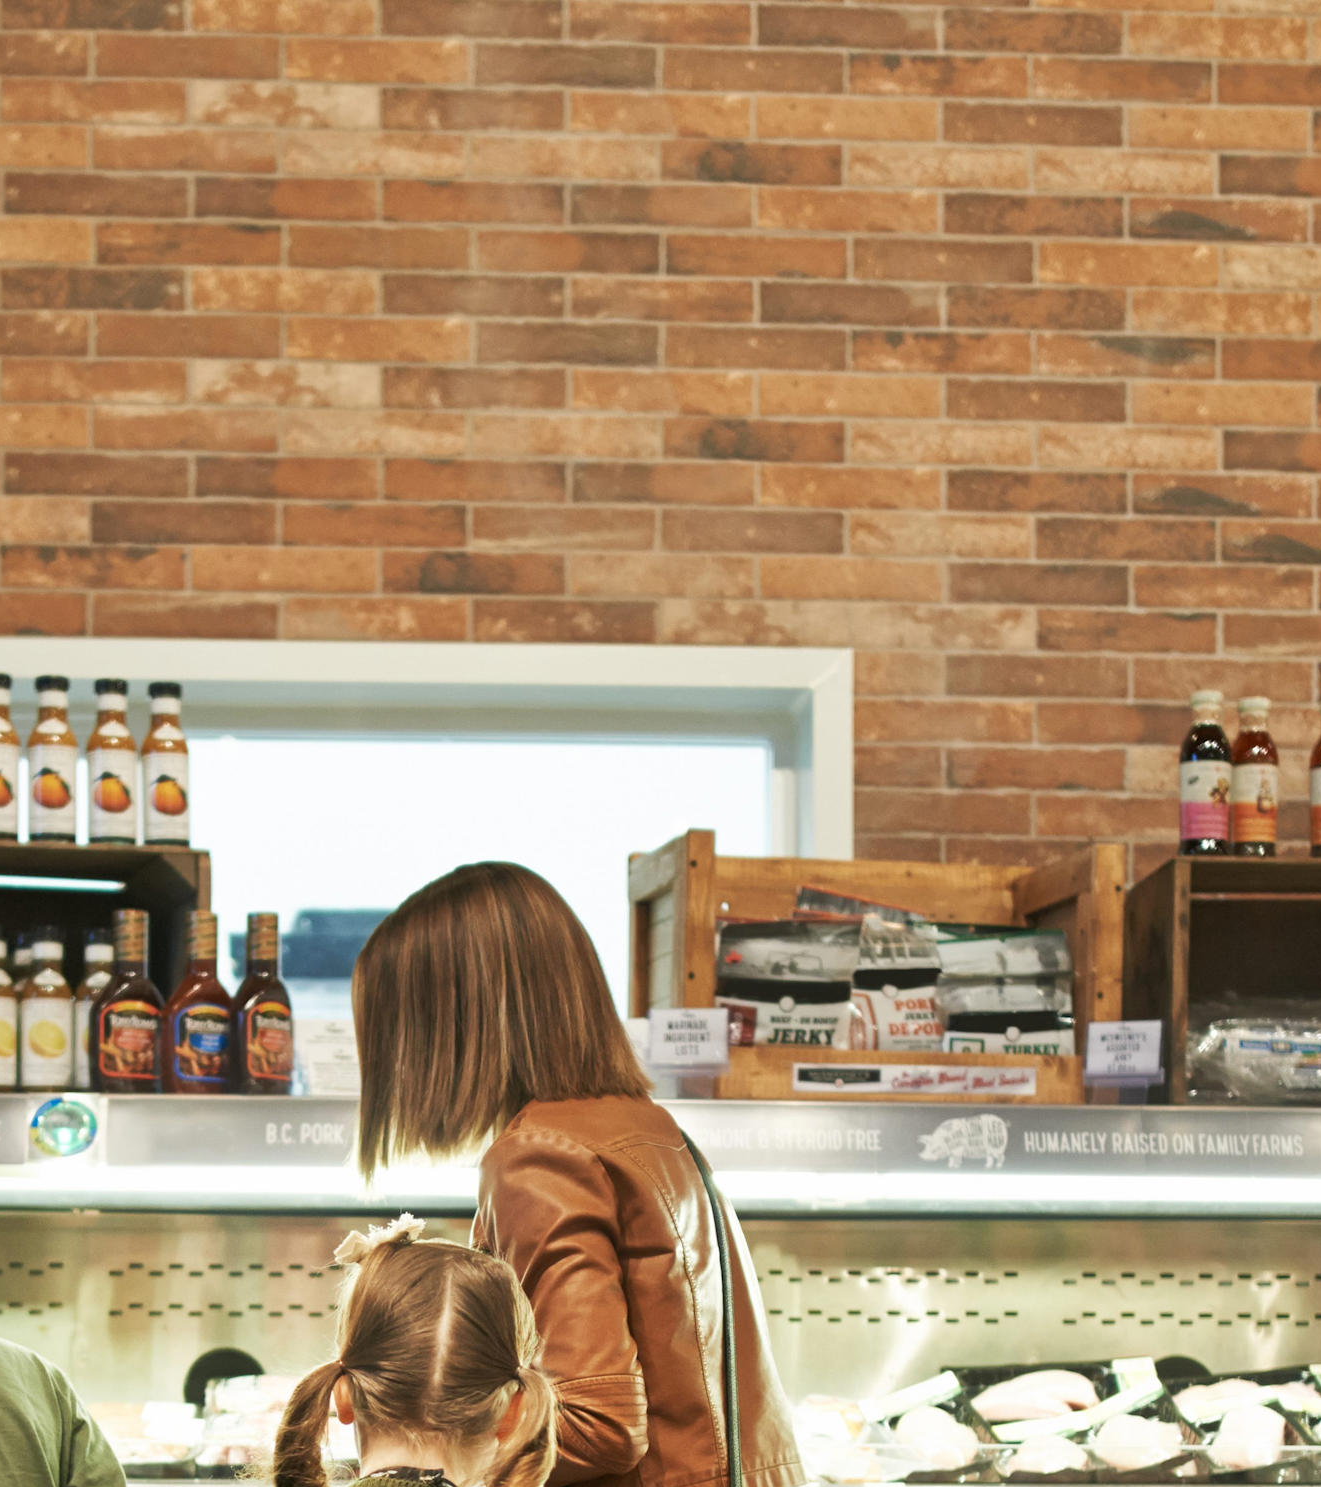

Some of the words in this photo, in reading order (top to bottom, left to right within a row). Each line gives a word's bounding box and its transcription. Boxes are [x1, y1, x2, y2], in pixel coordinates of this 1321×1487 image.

[767, 1028, 836, 1045] JERKY
[266, 1122, 297, 1144] B.C.
[300, 1123, 344, 1145] PORK
[775, 1128, 843, 1152] STEROID
[846, 1129, 882, 1152] FREE
[1024, 1131, 1106, 1154] HUMANELY
[1114, 1132, 1168, 1155] RAISED
[1173, 1132, 1196, 1155] ON
[1198, 1132, 1251, 1157] FAMILY
[1253, 1133, 1304, 1157] FARMS
